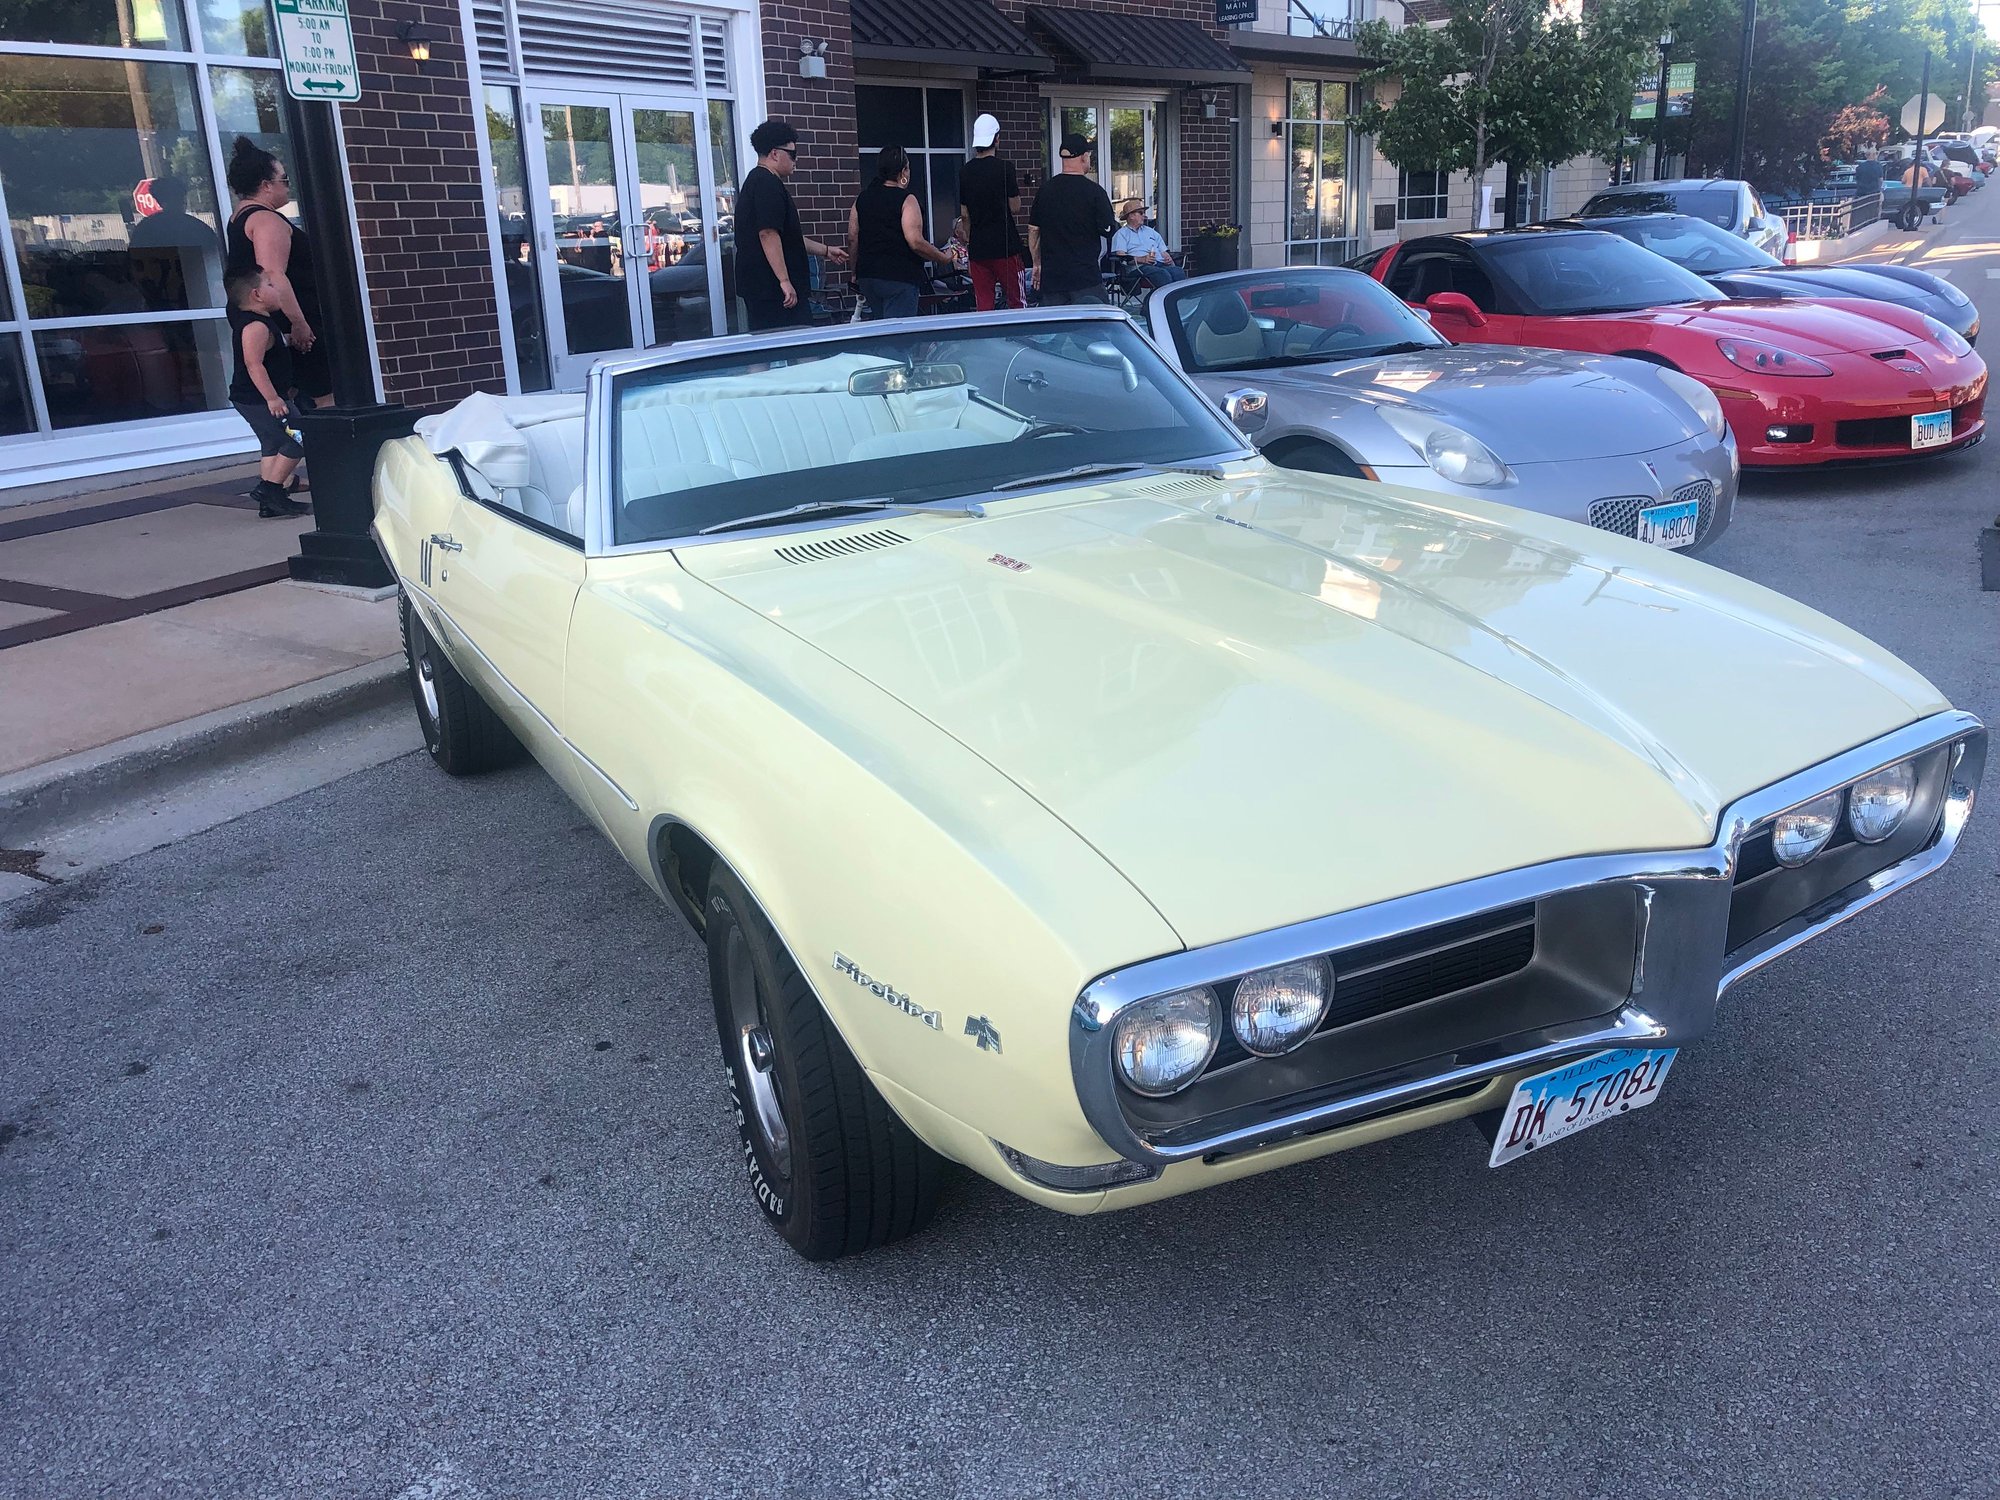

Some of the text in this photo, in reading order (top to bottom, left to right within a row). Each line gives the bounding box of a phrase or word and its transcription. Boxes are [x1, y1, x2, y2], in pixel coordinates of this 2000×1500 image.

[1225, 2, 1248, 10] MAIN
[297, 17, 331, 31] 5:00 AM
[1219, 12, 1255, 22] LEASING OFFICE
[311, 32, 322, 45] TO
[302, 46, 336, 60] 7:00 PM
[289, 61, 353, 76] MONDAY-FRIDAY
[1671, 67, 1694, 75] SHOP
[1670, 80, 1693, 88] DINE
[1917, 423, 1935, 442] BUD
[1642, 514, 1696, 544] AJ 48020
[832, 950, 943, 1031] Firebird
[1506, 1054, 1666, 1149] DK 57081
[1541, 1108, 1614, 1142] LAND OF LINCOLN
[744, 1139, 784, 1216] RADIAL
